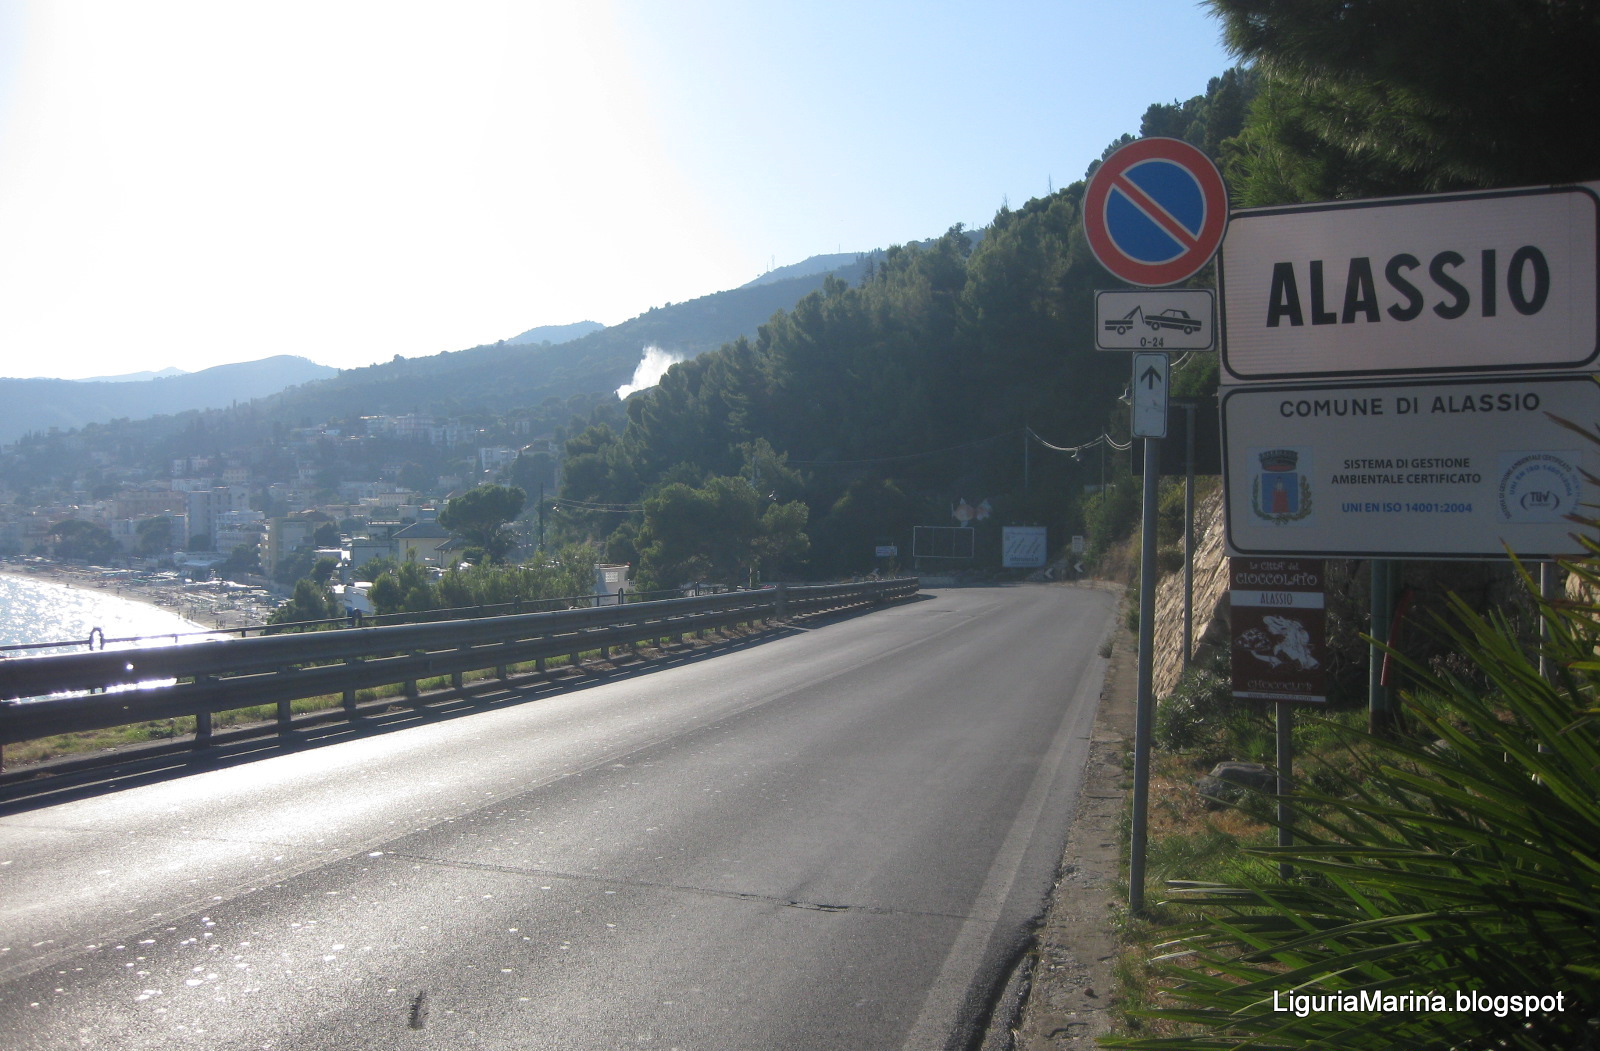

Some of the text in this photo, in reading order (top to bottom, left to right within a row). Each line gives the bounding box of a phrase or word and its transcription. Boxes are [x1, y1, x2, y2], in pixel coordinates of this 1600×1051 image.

[1266, 245, 1550, 328] ALASSIO
[1140, 337, 1164, 347] 0-24
[1280, 392, 1541, 418] COMUNE DI ALASSIO
[1344, 458, 1470, 469] SISTEMA DI GESTIONE
[1331, 473, 1482, 485] AMBIENTALE CERTIFICATO
[1342, 502, 1473, 513] UNI EN ISO 14001:2004
[1235, 572, 1318, 586] CIOCCOLATO
[1260, 592, 1293, 606] ALASSIO
